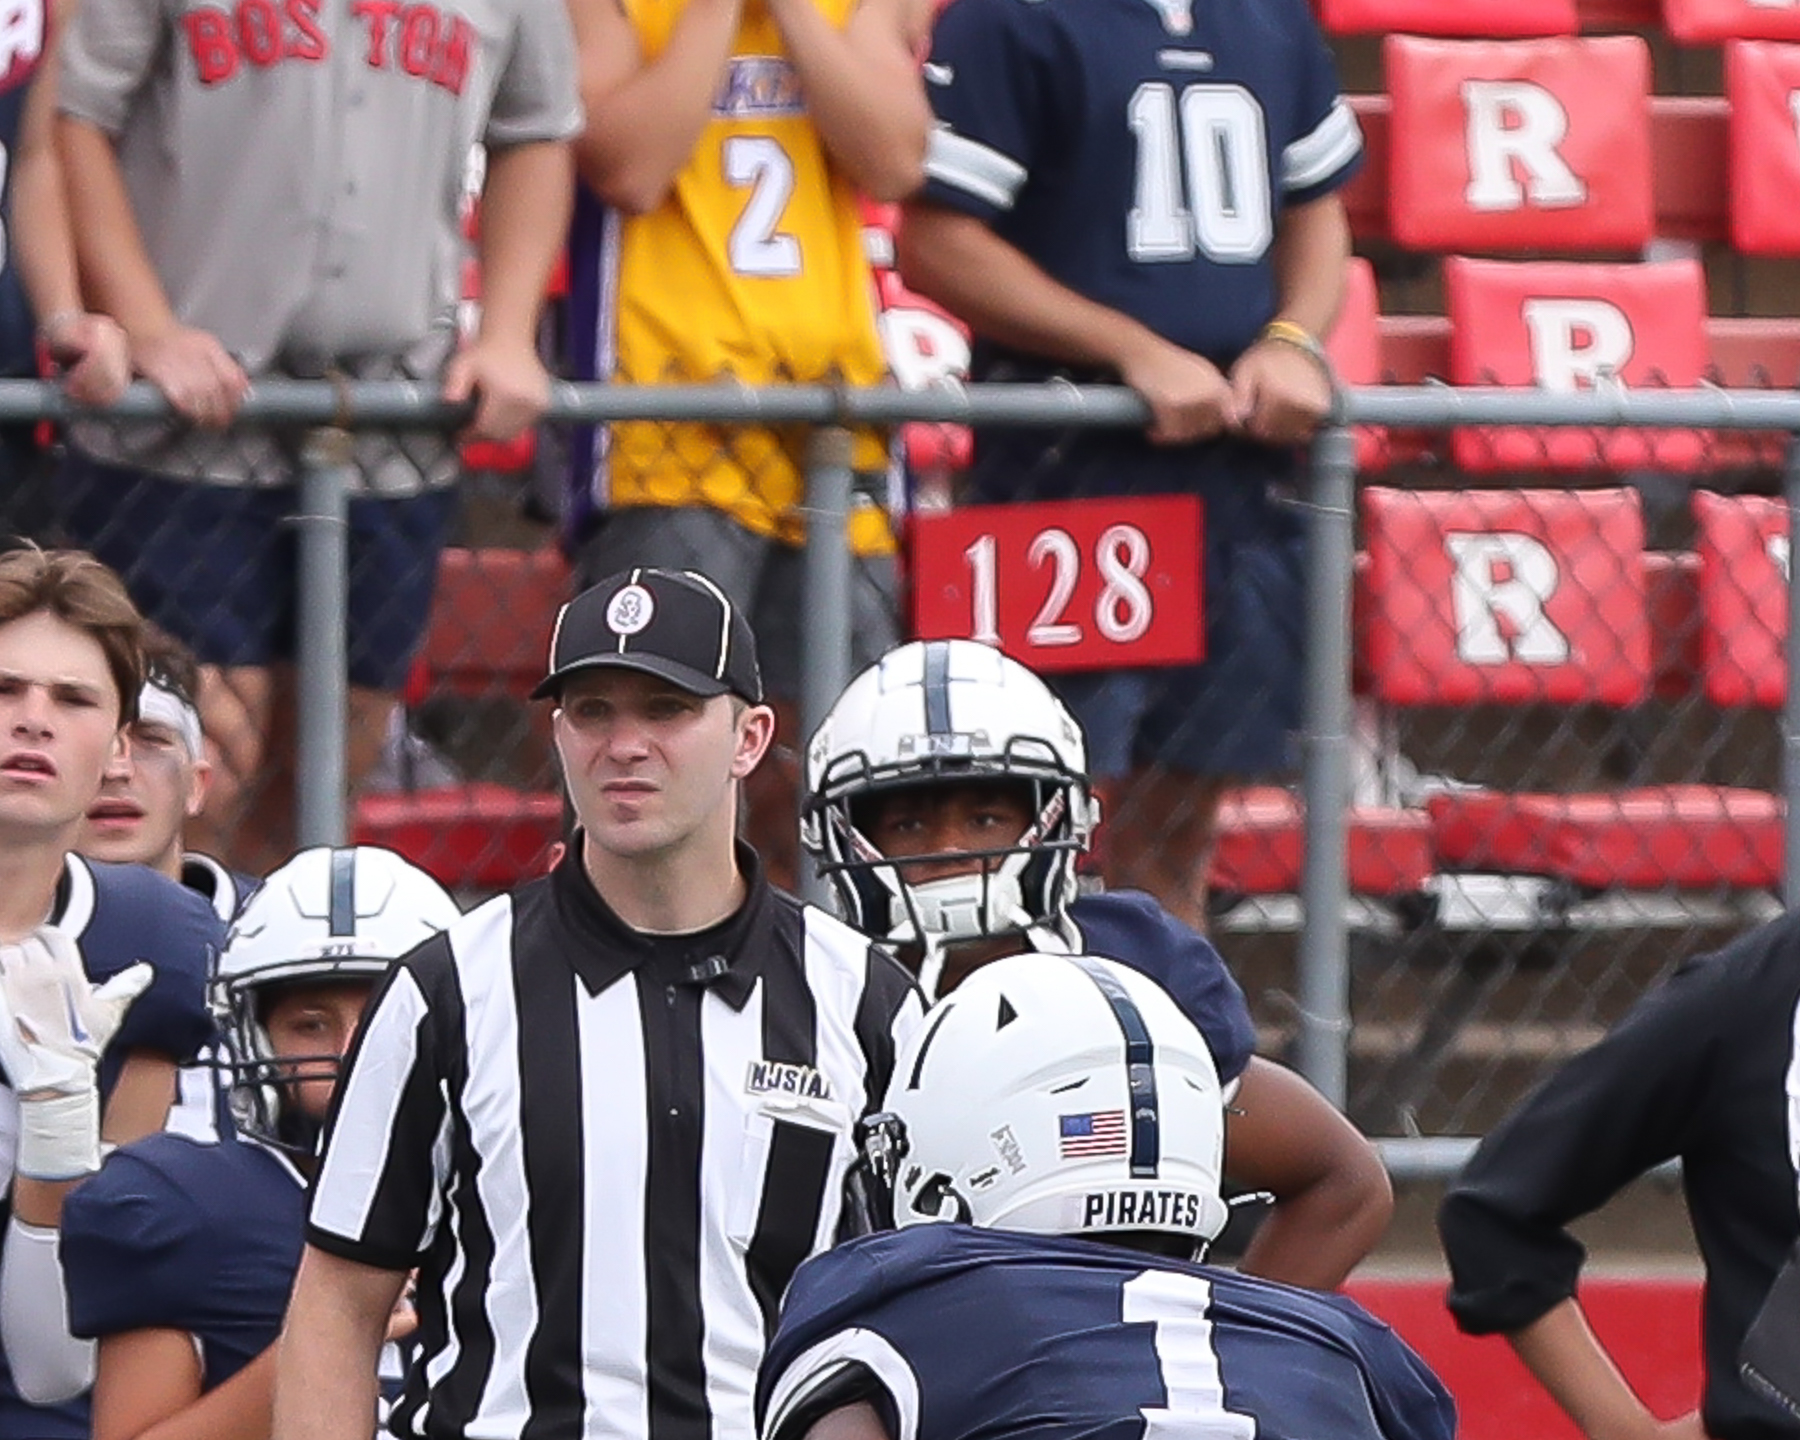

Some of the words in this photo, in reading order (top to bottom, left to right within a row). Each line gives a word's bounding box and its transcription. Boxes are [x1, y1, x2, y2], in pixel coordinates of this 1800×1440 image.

[723, 135, 804, 276] 2
[1126, 82, 1273, 264] 10
[1461, 79, 1587, 211] R
[964, 524, 1154, 647] 128
[1445, 530, 1570, 665] R
[1082, 1190, 1200, 1228] PIRATES
